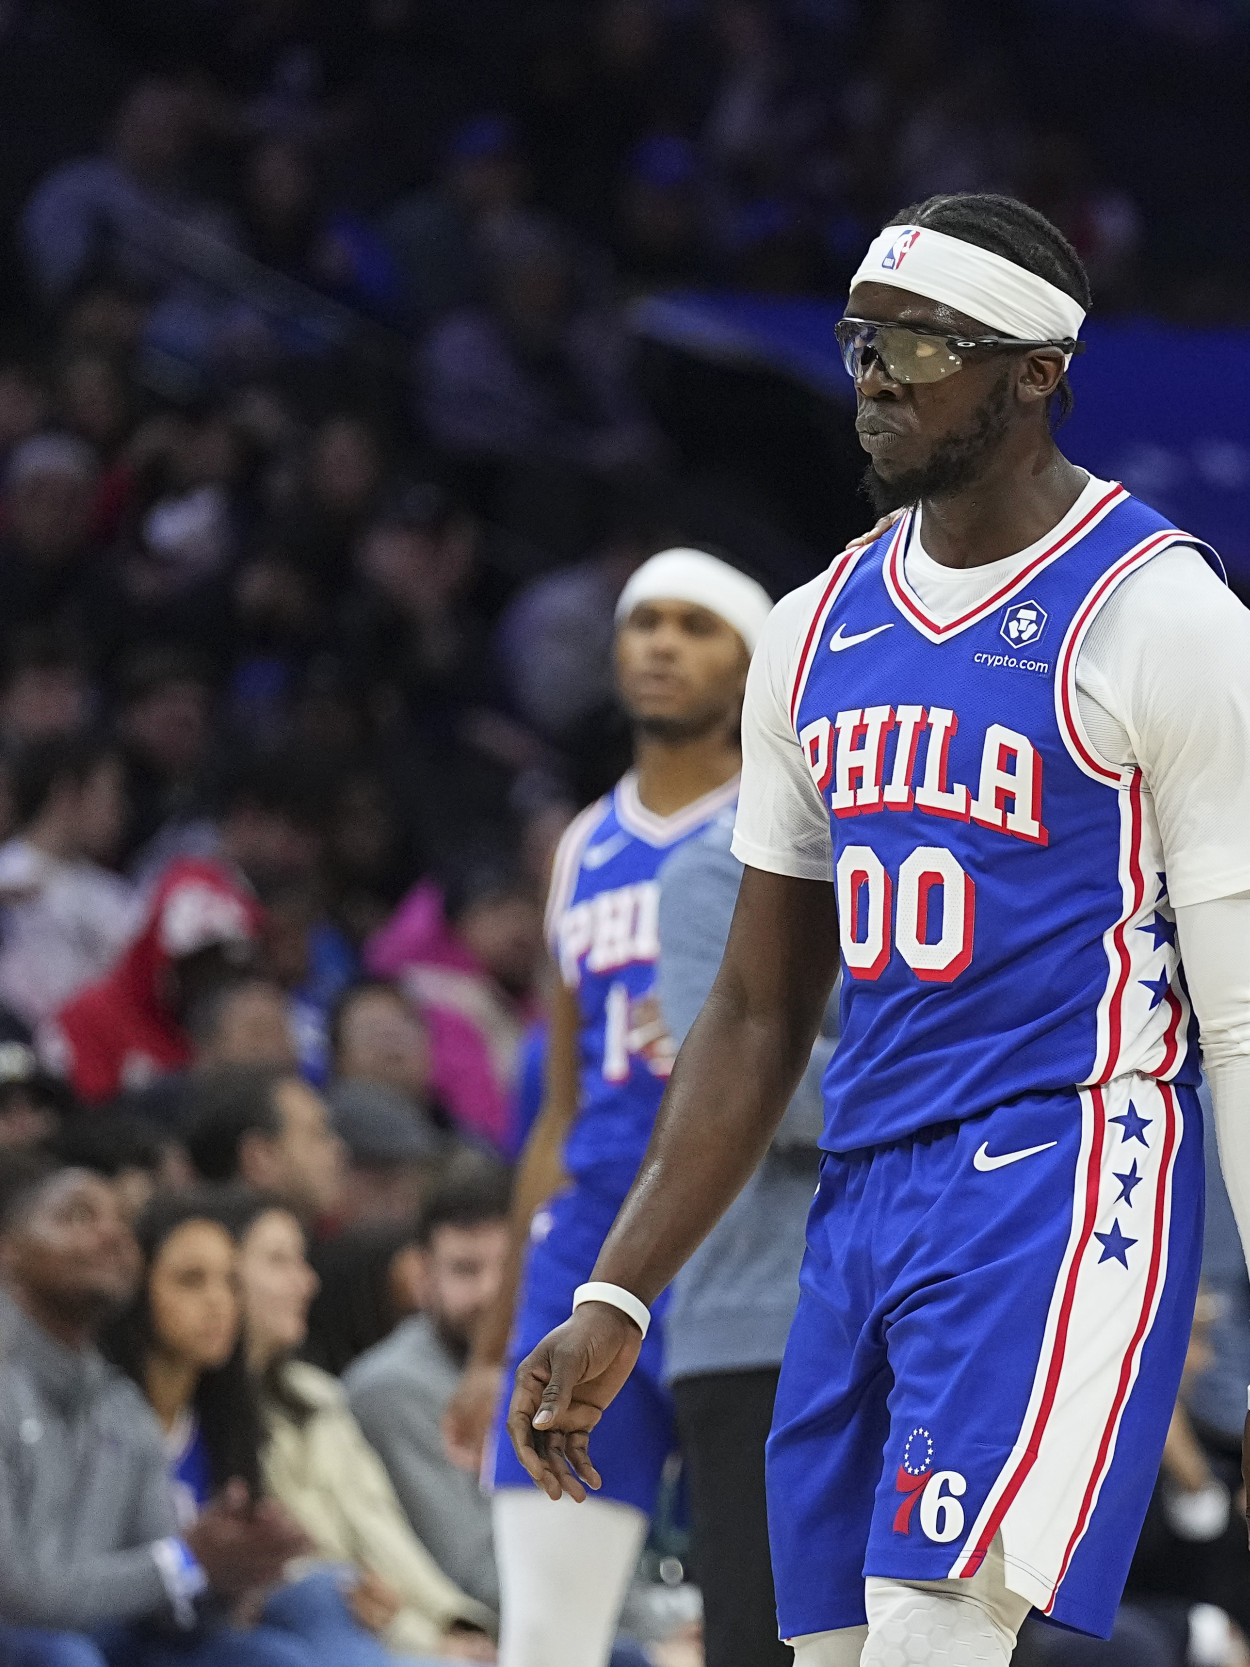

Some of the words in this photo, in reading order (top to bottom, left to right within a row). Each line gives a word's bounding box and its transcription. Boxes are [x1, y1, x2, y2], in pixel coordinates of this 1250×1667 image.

[974, 652, 1049, 673] crypto.com
[800, 704, 1049, 846] PHILA
[558, 880, 661, 988] PHI
[837, 846, 976, 983] 00
[893, 1464, 967, 1543] 76
